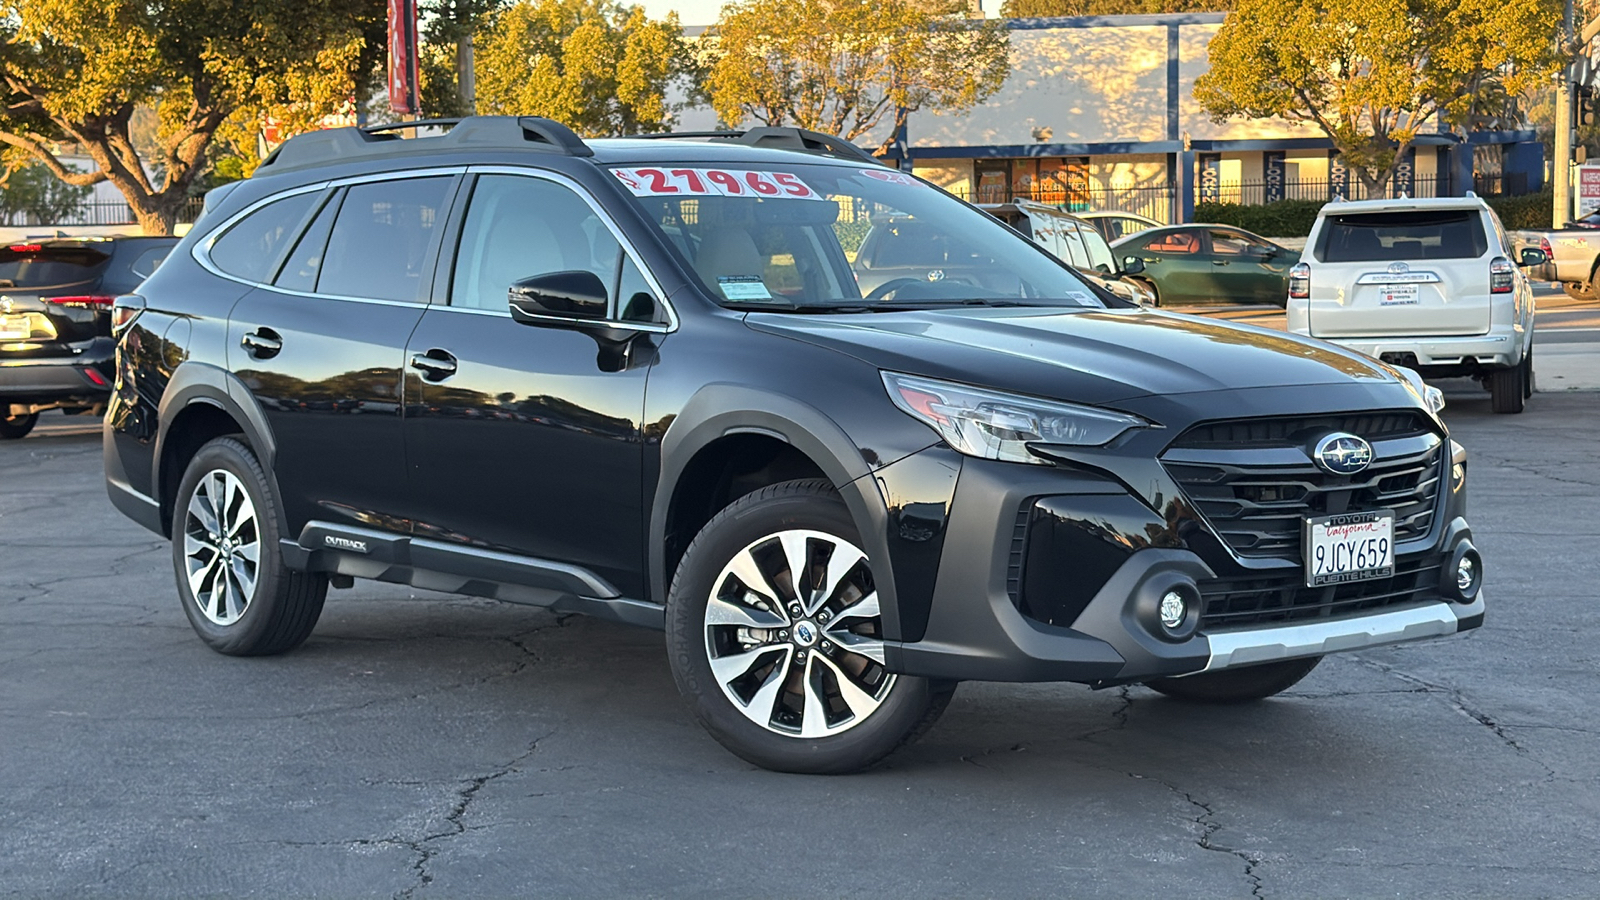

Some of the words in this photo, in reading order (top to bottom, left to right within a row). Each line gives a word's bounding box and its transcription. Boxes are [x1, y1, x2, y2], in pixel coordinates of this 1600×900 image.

[1332, 514, 1374, 524] TOYOTA
[1326, 523, 1379, 539] California
[325, 535, 366, 551] OUTBACK
[1316, 537, 1388, 575] 9JCY659
[1315, 573, 1358, 585] PUENTE
[1360, 568, 1390, 577] HILLS
